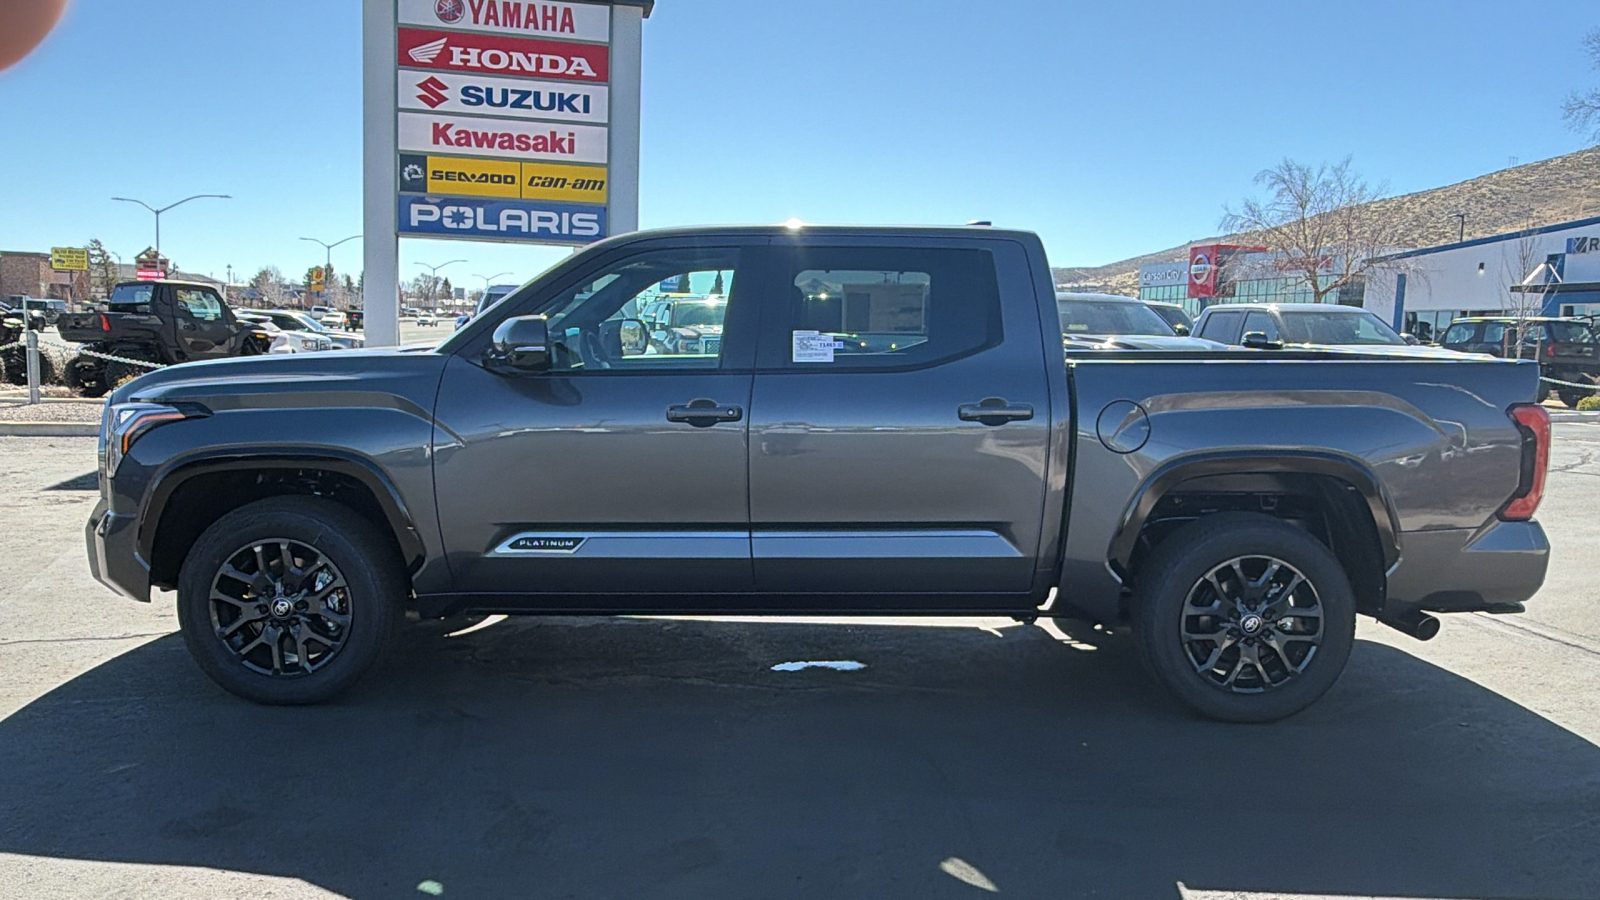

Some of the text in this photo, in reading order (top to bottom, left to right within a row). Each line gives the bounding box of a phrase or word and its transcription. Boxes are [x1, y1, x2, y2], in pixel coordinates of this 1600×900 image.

[468, 0, 575, 34] YAMAHA
[449, 46, 597, 77] HONDA
[460, 85, 590, 114] SUZUKI
[432, 122, 575, 154] Kawasaki
[527, 175, 604, 191] can-am
[410, 204, 599, 236] POLARIS
[1142, 269, 1180, 281] Carson City
